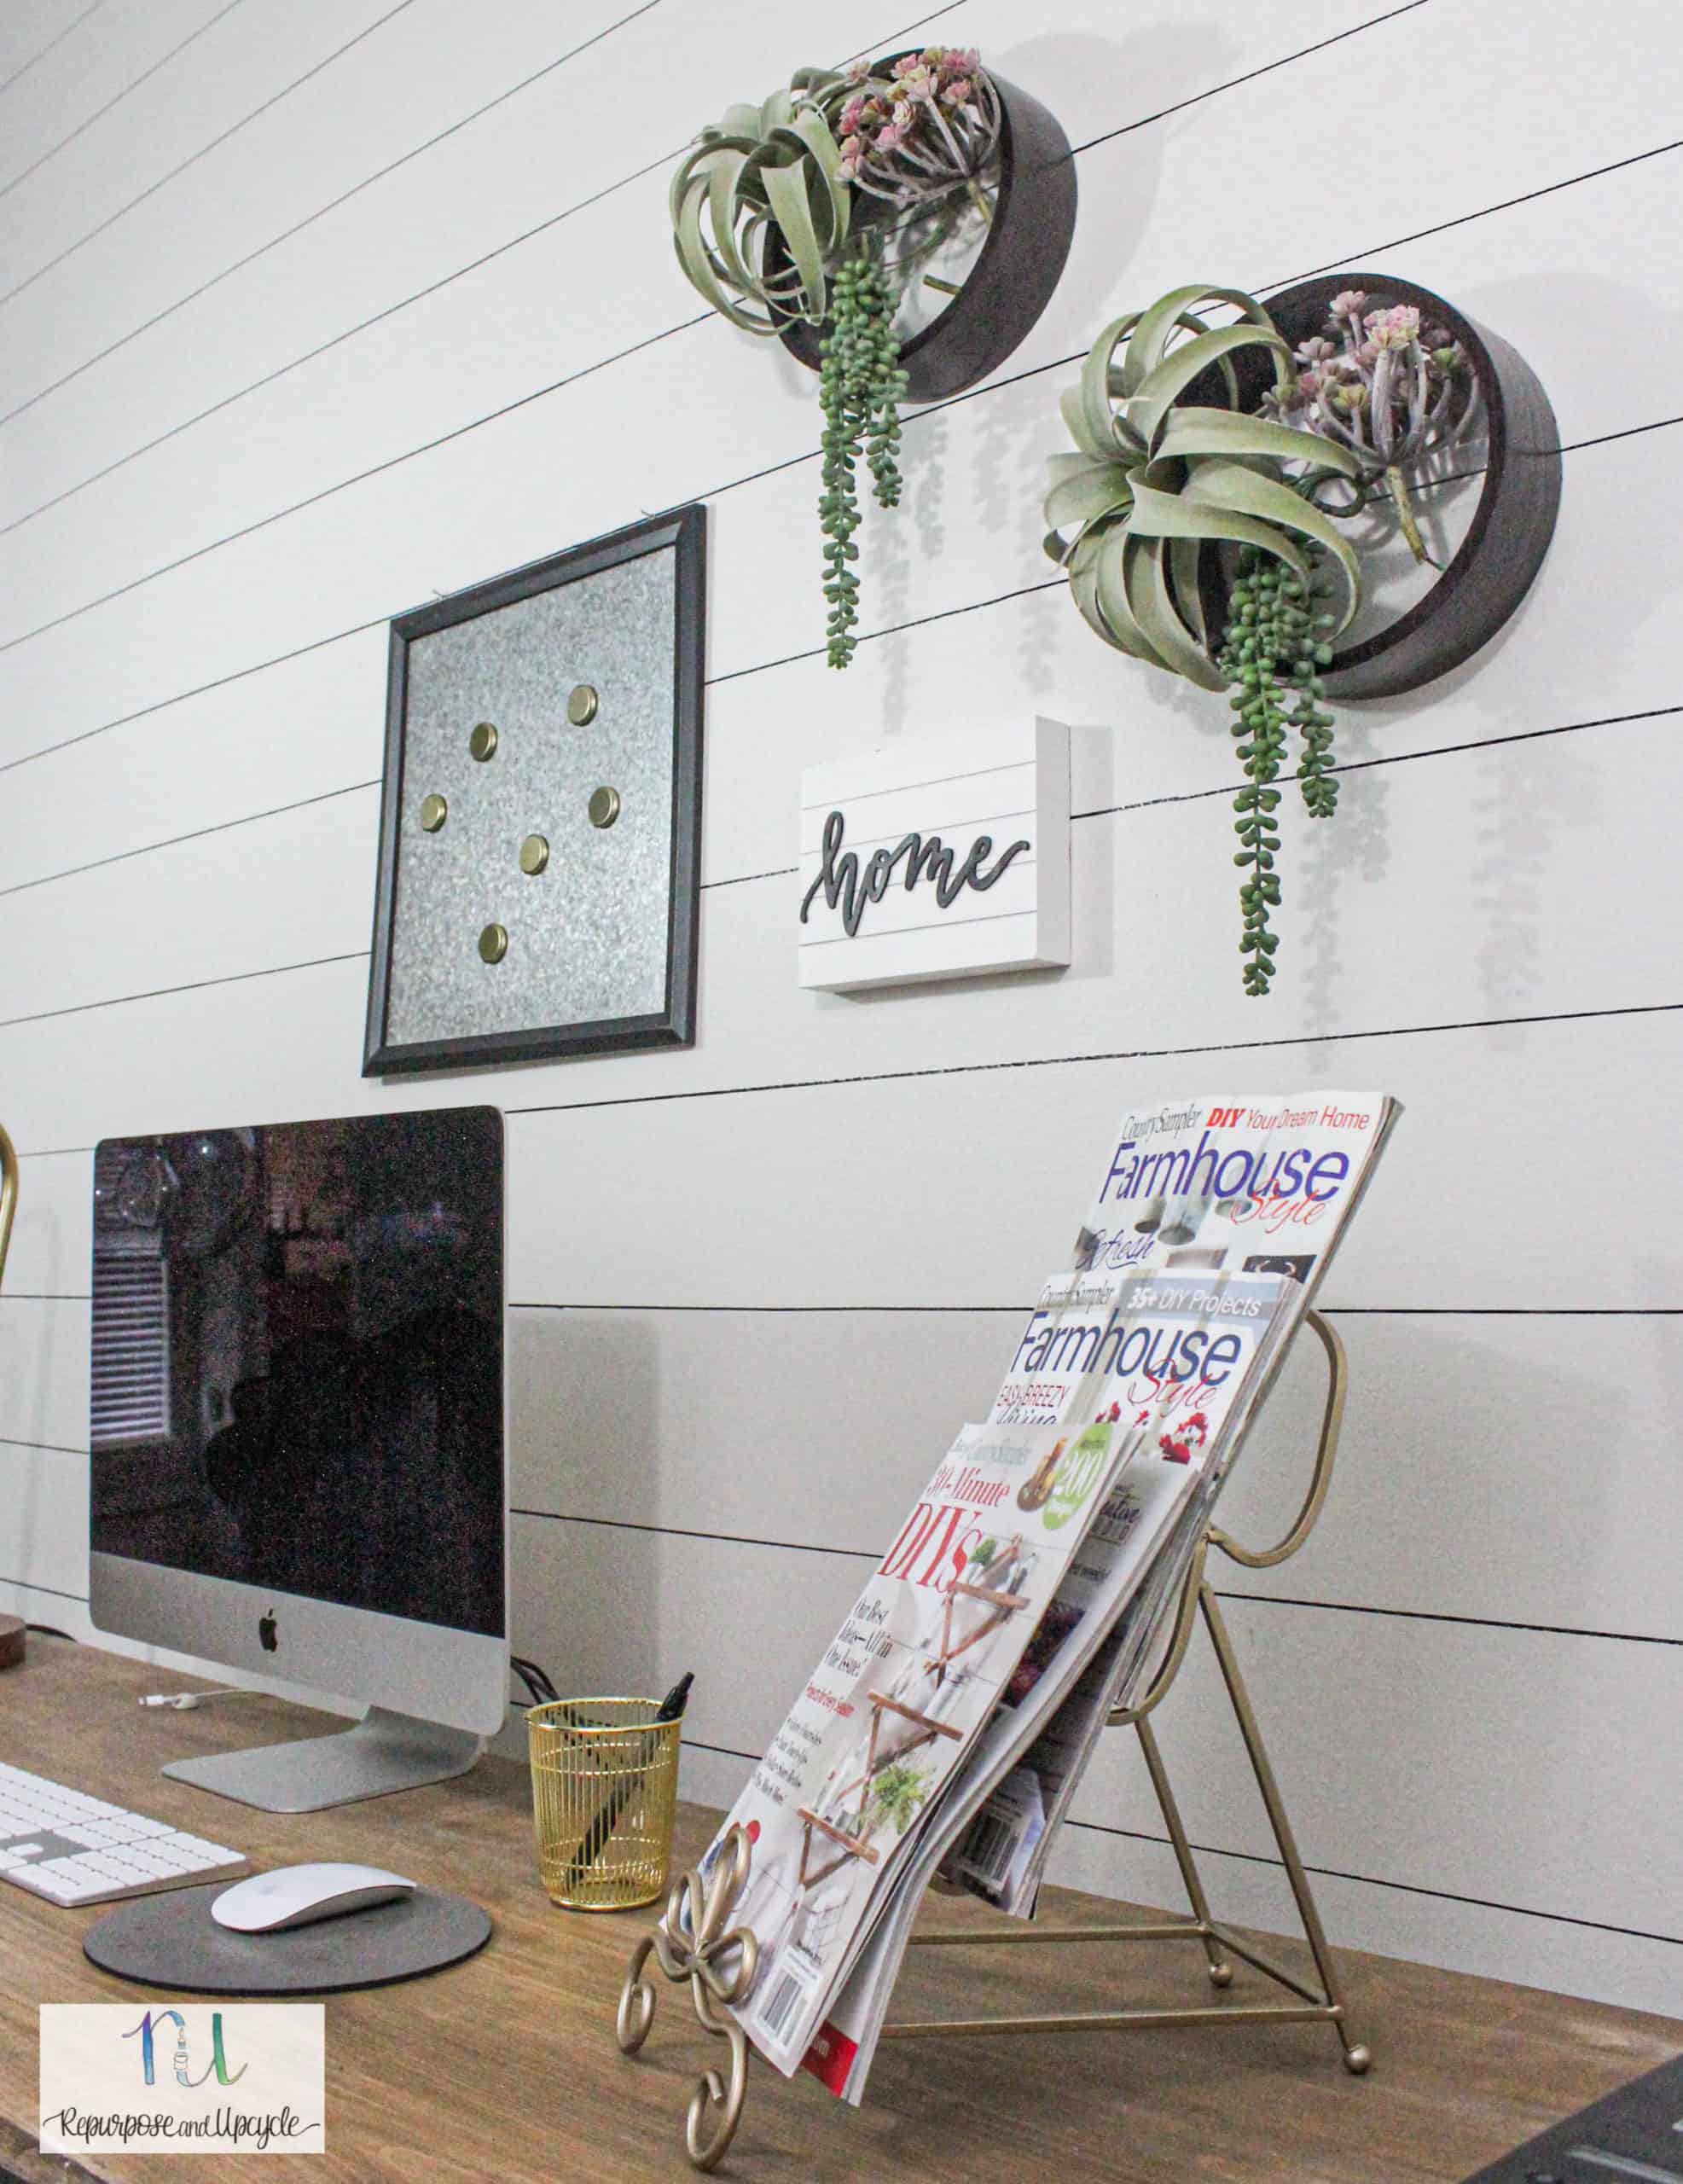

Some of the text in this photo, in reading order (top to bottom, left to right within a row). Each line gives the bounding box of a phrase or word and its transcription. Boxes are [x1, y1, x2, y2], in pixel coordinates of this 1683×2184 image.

[799, 811, 1030, 937] home
[1206, 1105, 1370, 1130] DIY Your Dream Home
[1099, 1130, 1350, 1204] Farmhouse
[1229, 1178, 1326, 1234] Style
[1127, 1288, 1262, 1317] 35+ DIY Projects
[1010, 1307, 1242, 1386] Farmhouse
[1127, 1357, 1219, 1418] Style
[878, 1503, 983, 1593] DIYs
